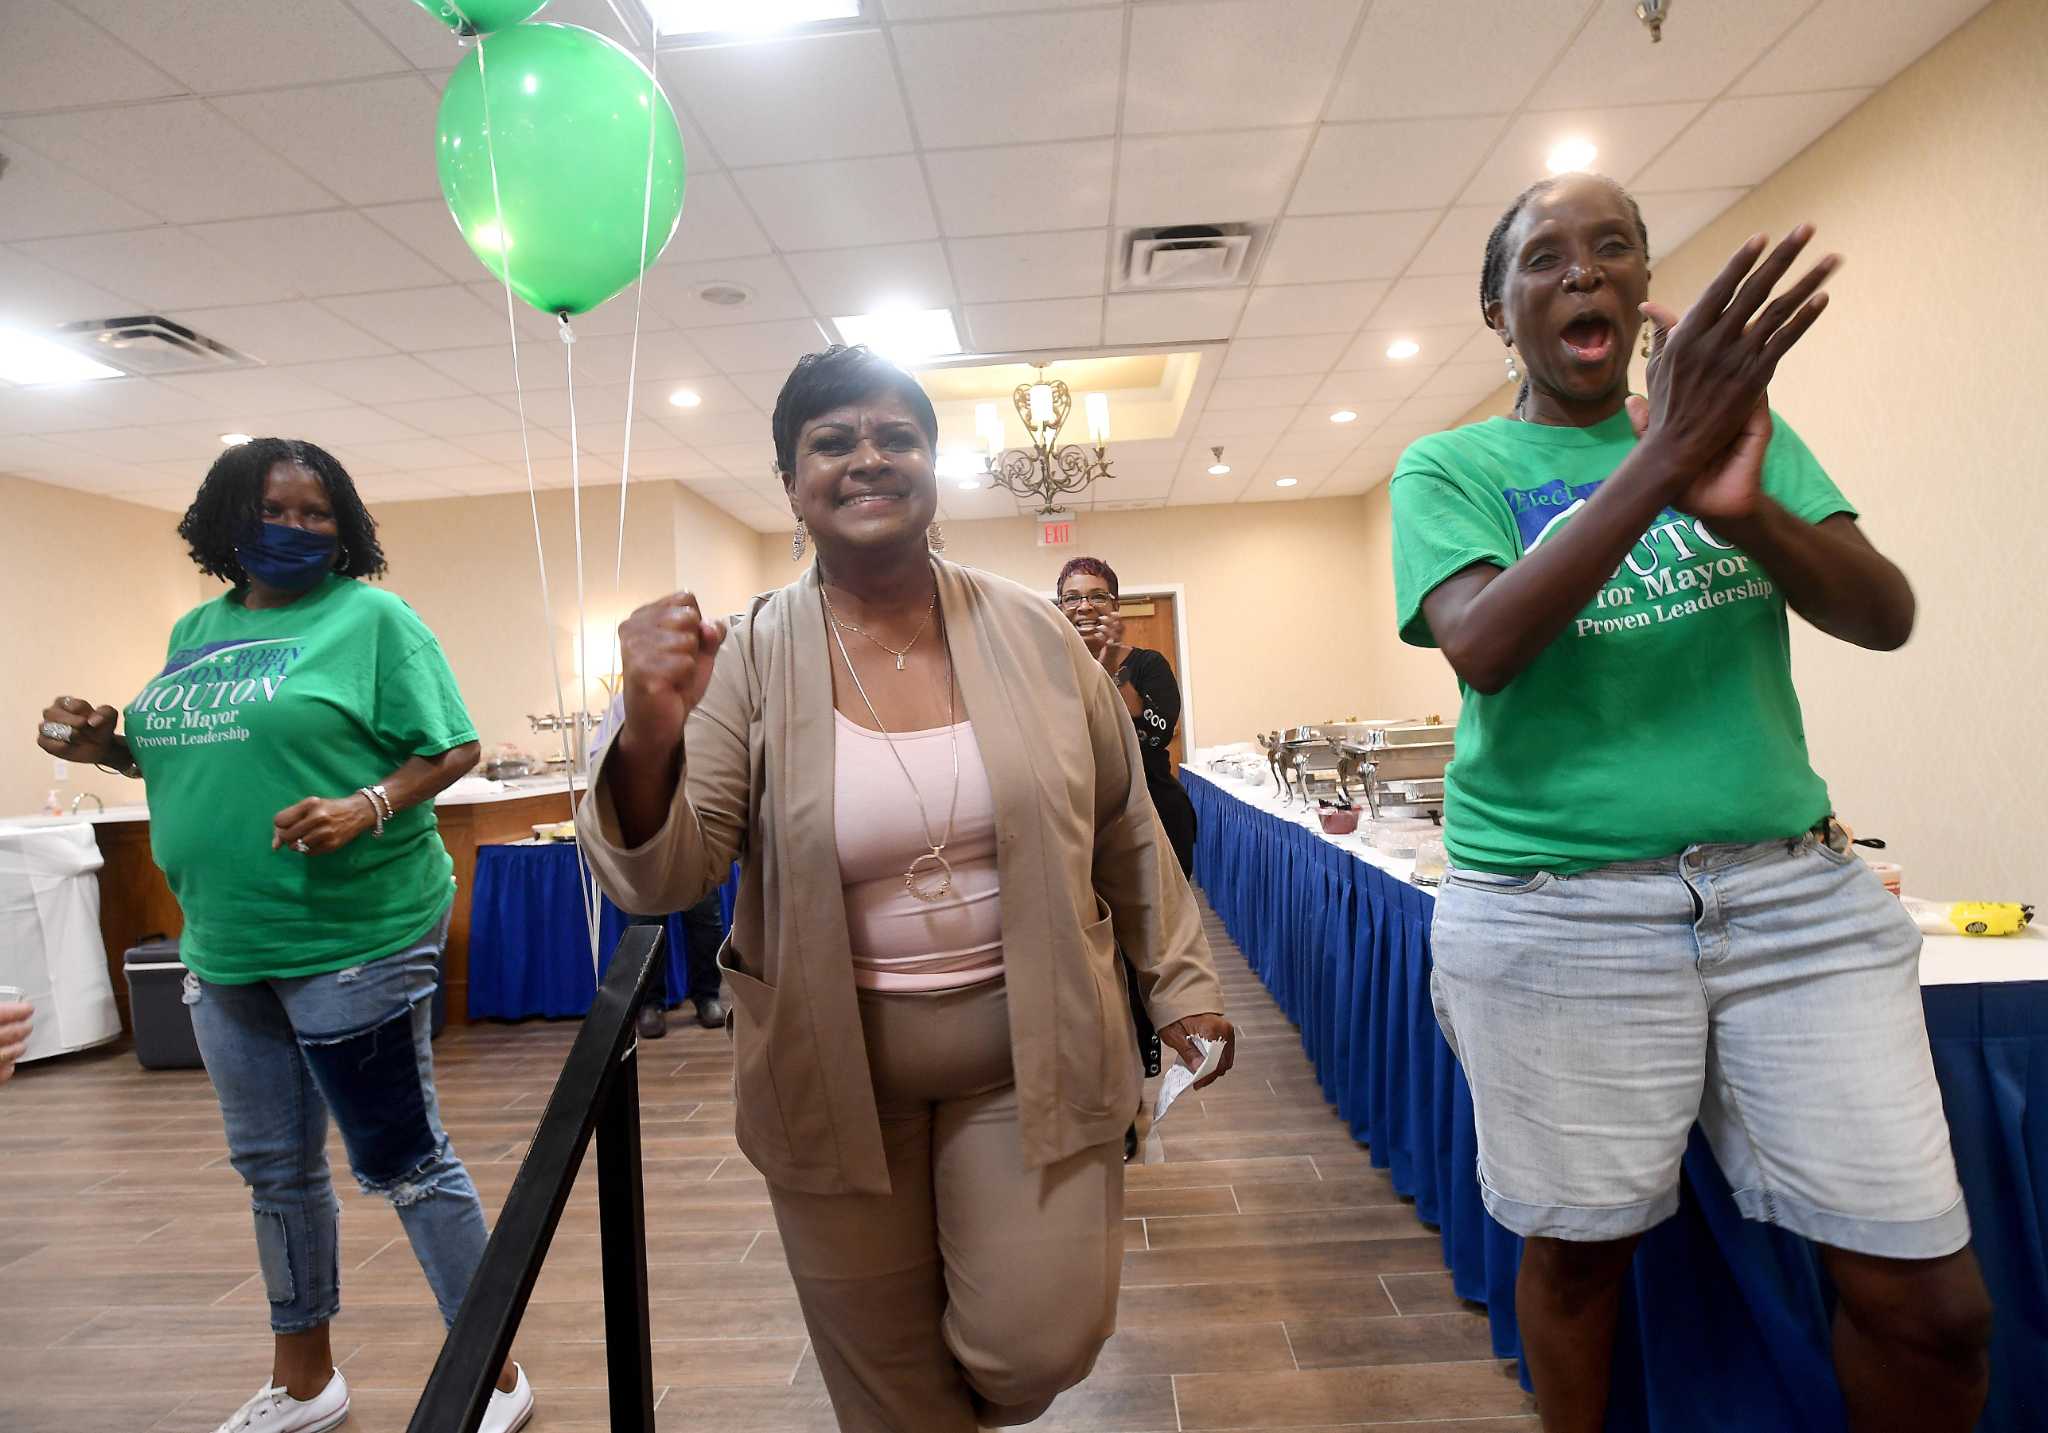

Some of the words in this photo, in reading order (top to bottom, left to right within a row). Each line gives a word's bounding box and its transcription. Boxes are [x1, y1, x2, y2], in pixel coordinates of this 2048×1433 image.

[1513, 486, 1577, 513] Elect
[1045, 523, 1070, 545] EXIT
[1596, 582, 1635, 609] for
[1640, 555, 1749, 600] Mayor
[1576, 612, 1651, 638] Proven
[1653, 577, 1774, 623] Leadership
[129, 675, 287, 714] MOUTON
[145, 711, 176, 730] for
[180, 708, 240, 730] Mayor
[135, 734, 177, 748] Proven
[181, 726, 250, 746] Leadership
